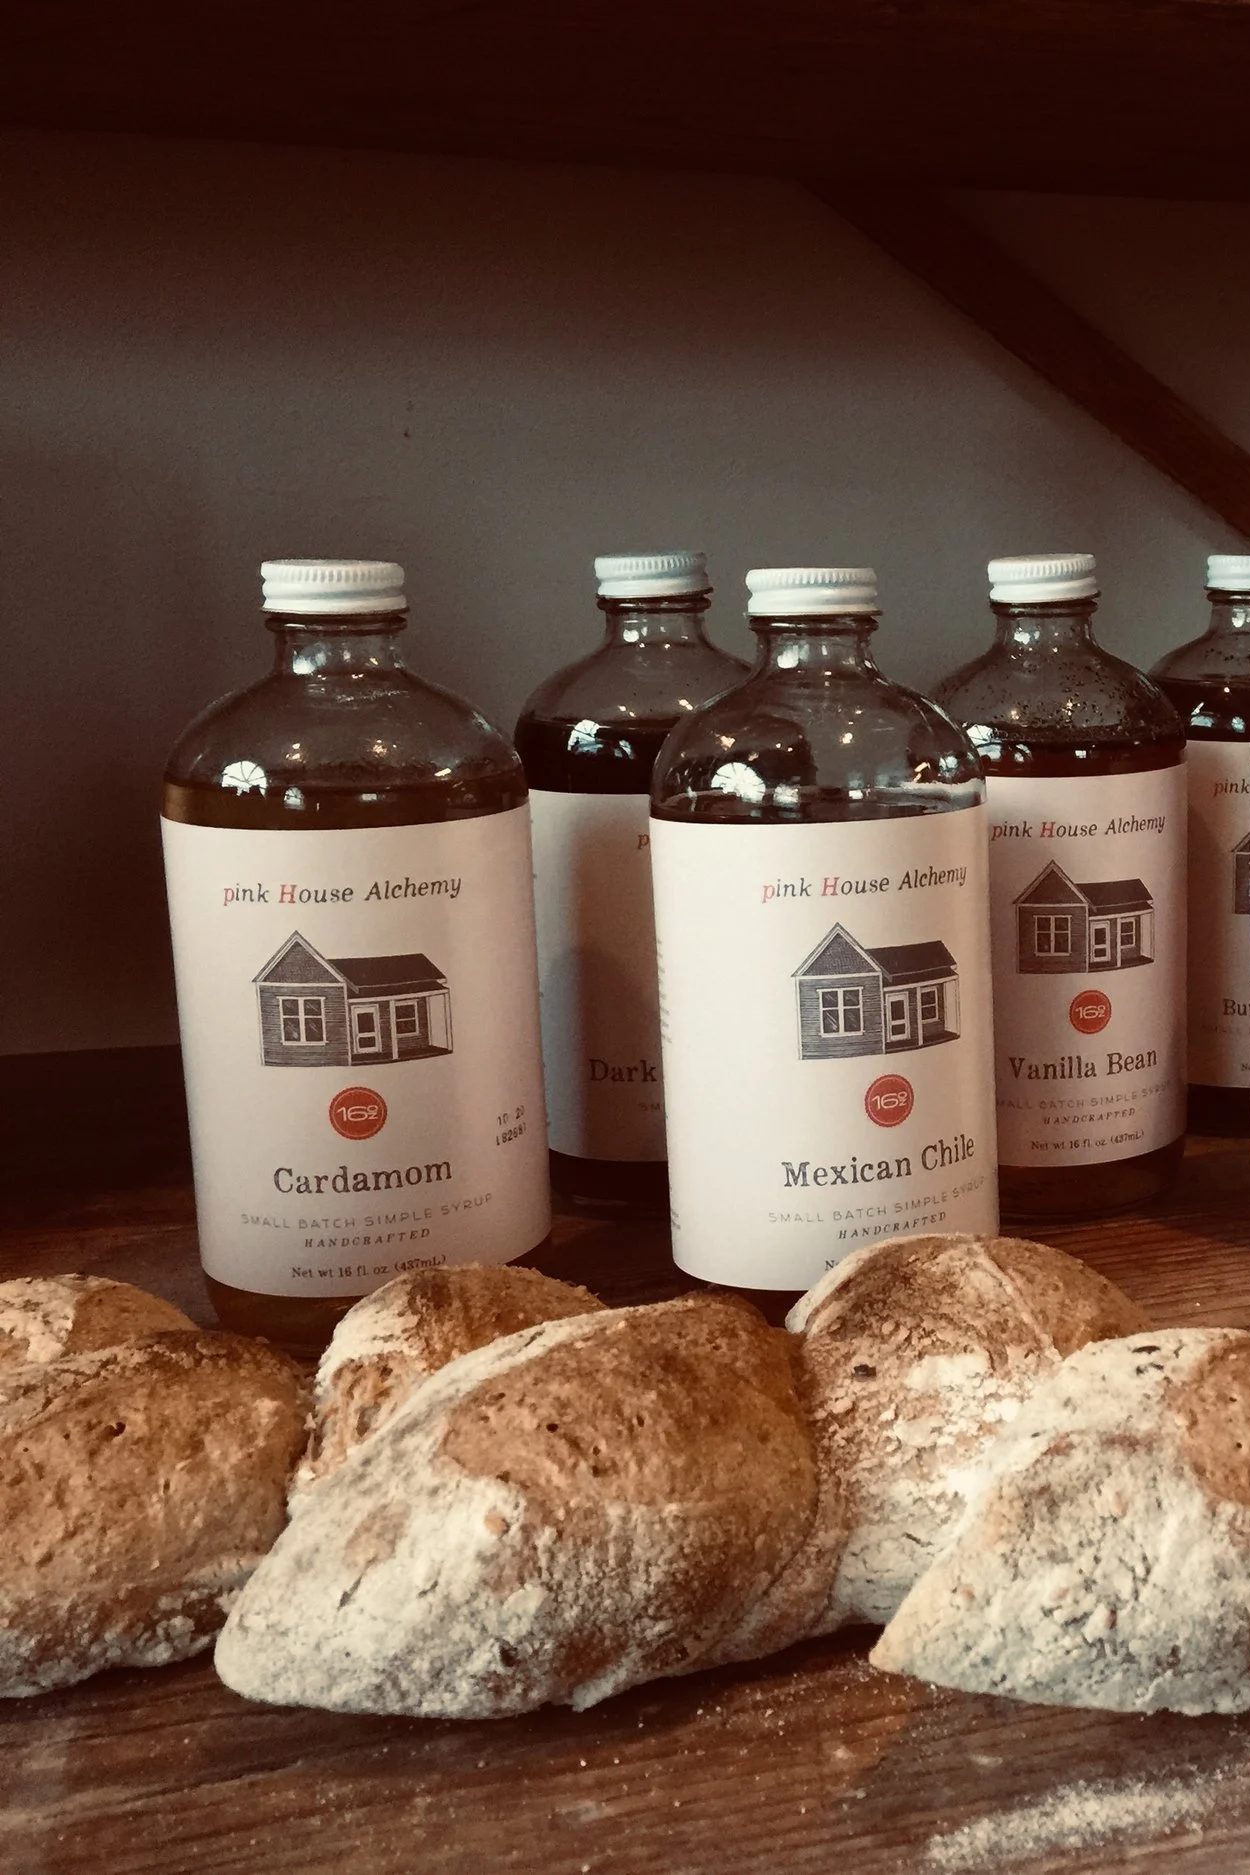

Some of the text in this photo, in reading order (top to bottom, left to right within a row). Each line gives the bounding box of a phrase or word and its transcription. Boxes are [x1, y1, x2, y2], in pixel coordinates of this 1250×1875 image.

[1213, 778, 1250, 797] pink
[990, 815, 1166, 841] pink House Alchemy
[223, 877, 461, 906] pink House Alchemy
[761, 866, 967, 904] pink House Alchemy
[588, 1059, 657, 1082] Dark
[1008, 1050, 1157, 1080] Vanilla Bean
[997, 1100, 1033, 1109] ALL
[1039, 1099, 1084, 1109] BATCH
[1090, 1092, 1137, 1107] SIMPLE
[1043, 1108, 1136, 1125] HANDCRAFTED
[1031, 1141, 1049, 1150] Net
[1053, 1140, 1065, 1149] wt
[1069, 1140, 1080, 1149] 16
[1095, 1138, 1107, 1147] oz
[1110, 1129, 1145, 1144] (437mL)
[781, 1134, 975, 1188] Mexican Chile
[273, 1161, 453, 1194] Cardamom
[241, 1193, 493, 1230] SMALL BATCH SIMPLE SYRUP
[768, 1175, 985, 1223] SMALL BATCH SIMPLE SYRUP
[304, 1228, 431, 1248] HANDCRAFTED
[838, 1211, 947, 1240] HANDCRAFTED
[291, 1267, 313, 1279] Net
[318, 1266, 333, 1278] wt
[338, 1266, 353, 1278] 16
[373, 1264, 388, 1275] oz
[394, 1254, 447, 1273] (437mL)
